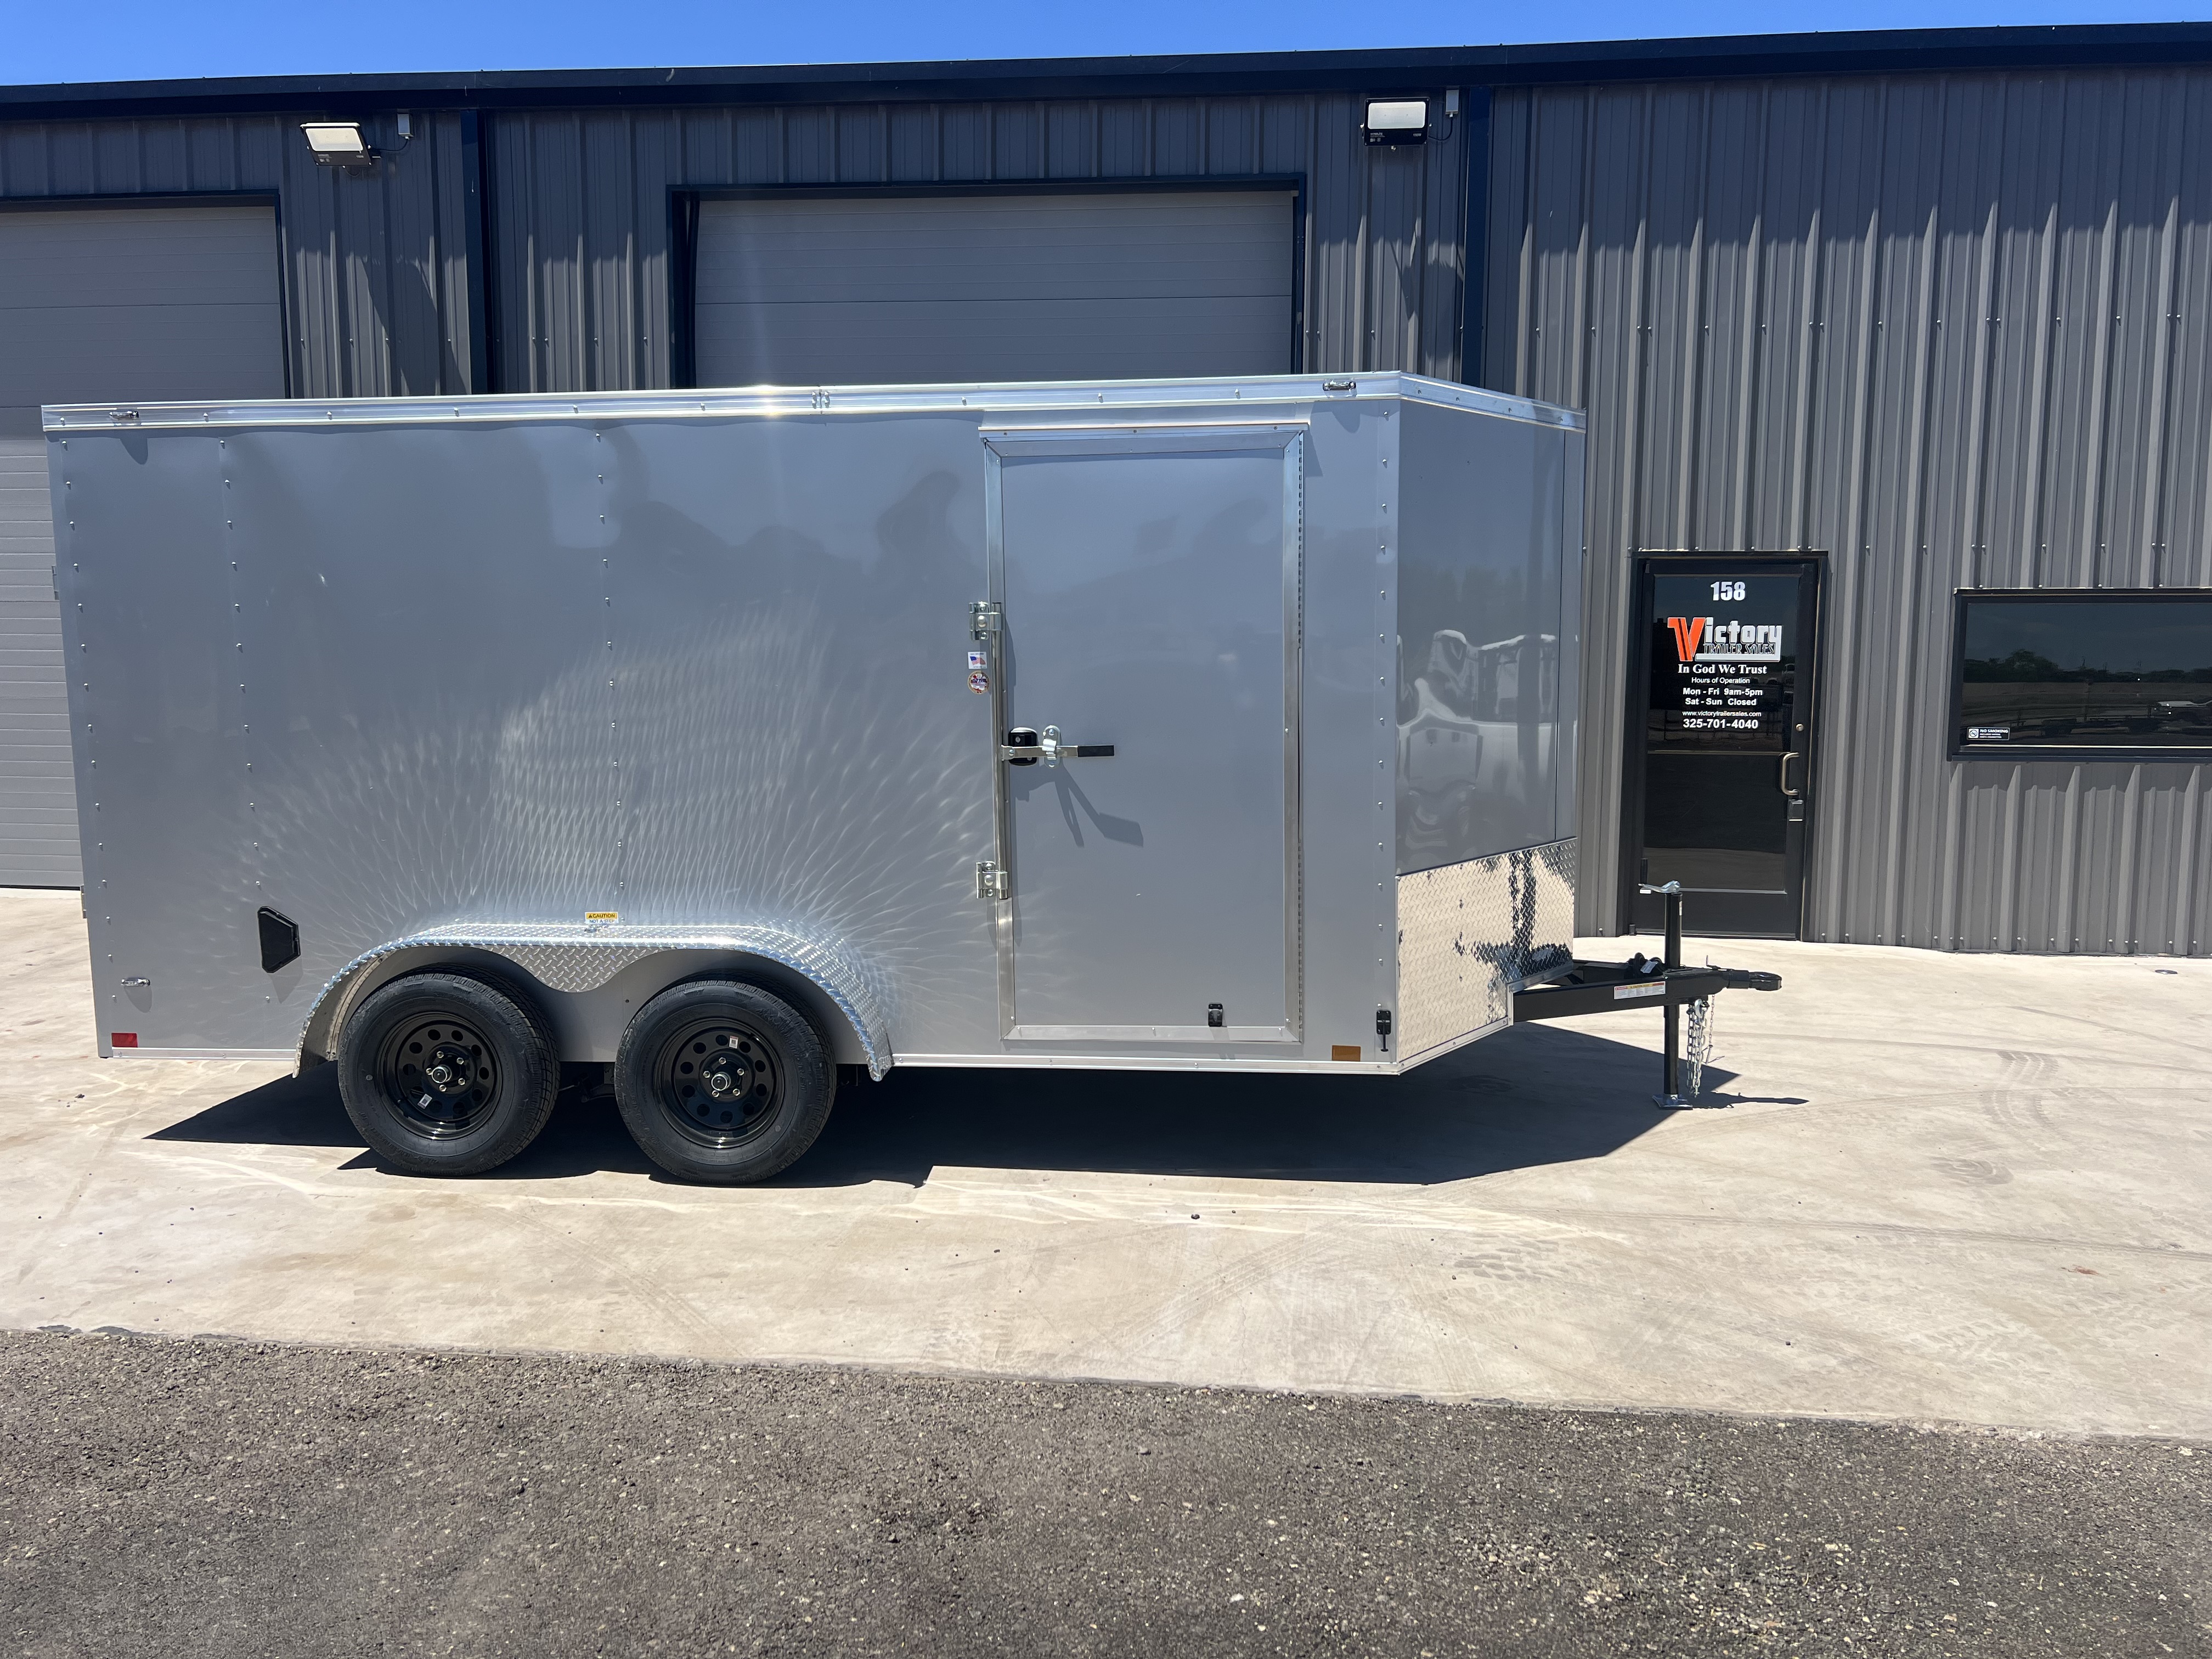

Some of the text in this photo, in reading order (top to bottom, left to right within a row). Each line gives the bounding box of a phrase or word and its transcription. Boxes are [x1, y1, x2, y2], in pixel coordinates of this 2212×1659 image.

[1710, 581, 1746, 601] 158
[1667, 617, 1782, 662] Victory
[1703, 644, 1776, 654] TRAILER SALES
[1678, 664, 1768, 674] In God We Trust
[1724, 688, 1763, 697] 9am-5pm
[1683, 719, 1758, 729] 325-701-4040
